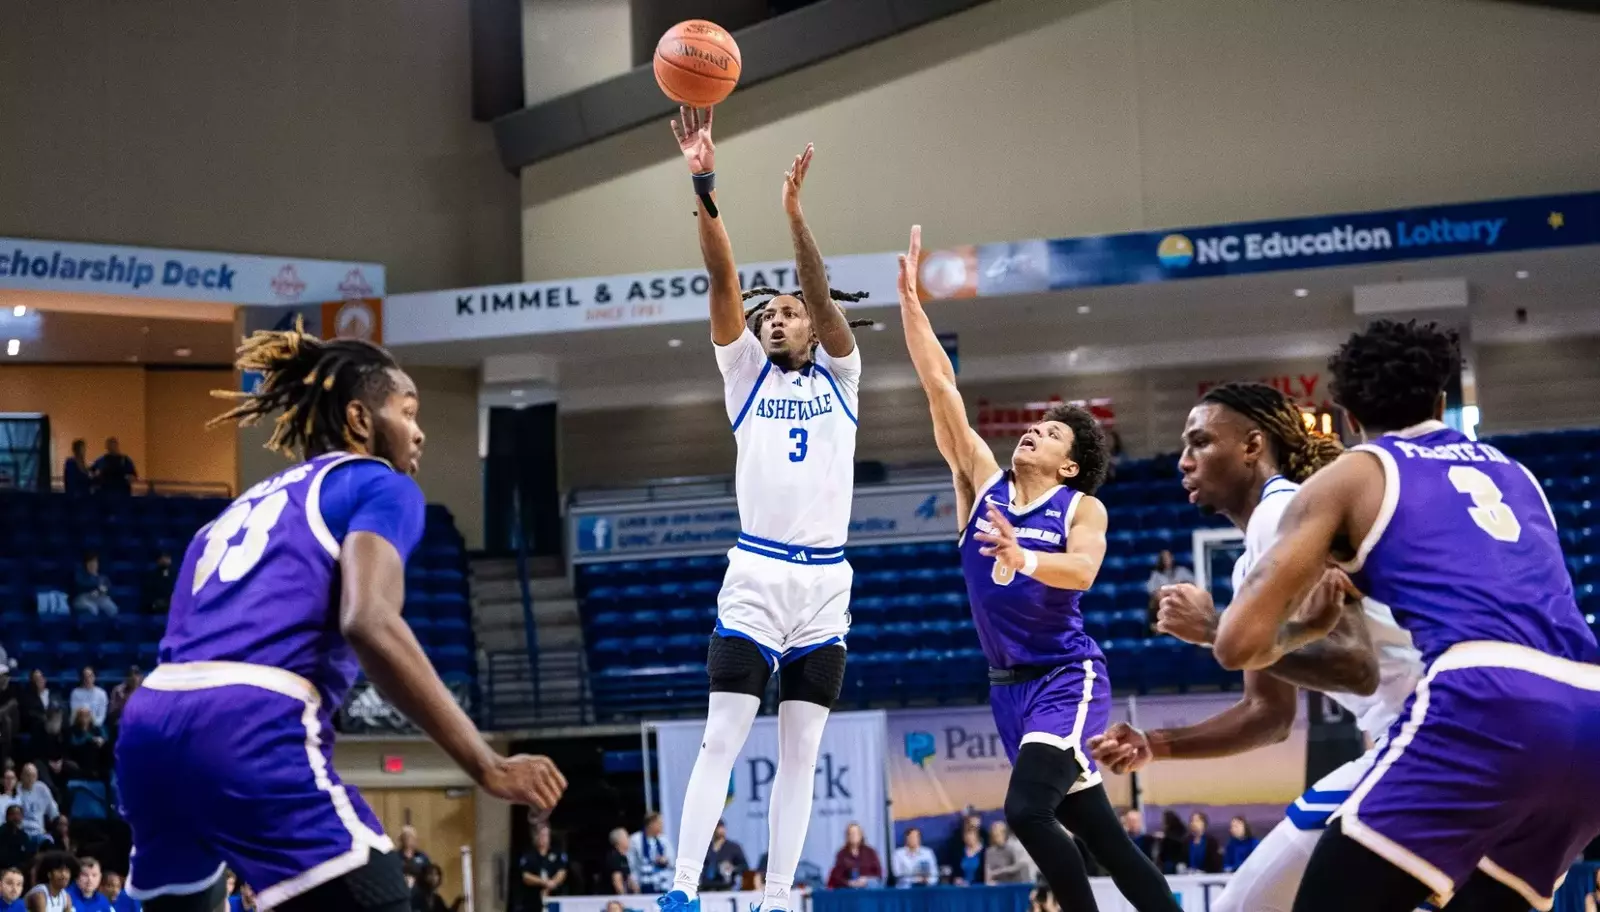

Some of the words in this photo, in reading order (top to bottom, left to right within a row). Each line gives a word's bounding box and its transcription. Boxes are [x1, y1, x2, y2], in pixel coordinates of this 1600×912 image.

[1196, 235, 1241, 264] NC
[1244, 224, 1393, 261] Education
[1396, 217, 1507, 247] Lottery
[161, 259, 236, 291] Deck
[455, 286, 581, 316] KIMMEL
[594, 283, 612, 304] &
[756, 393, 833, 420] ASHEVILLE
[788, 427, 809, 463] 3
[1447, 465, 1522, 543] 3
[191, 488, 289, 597] 33
